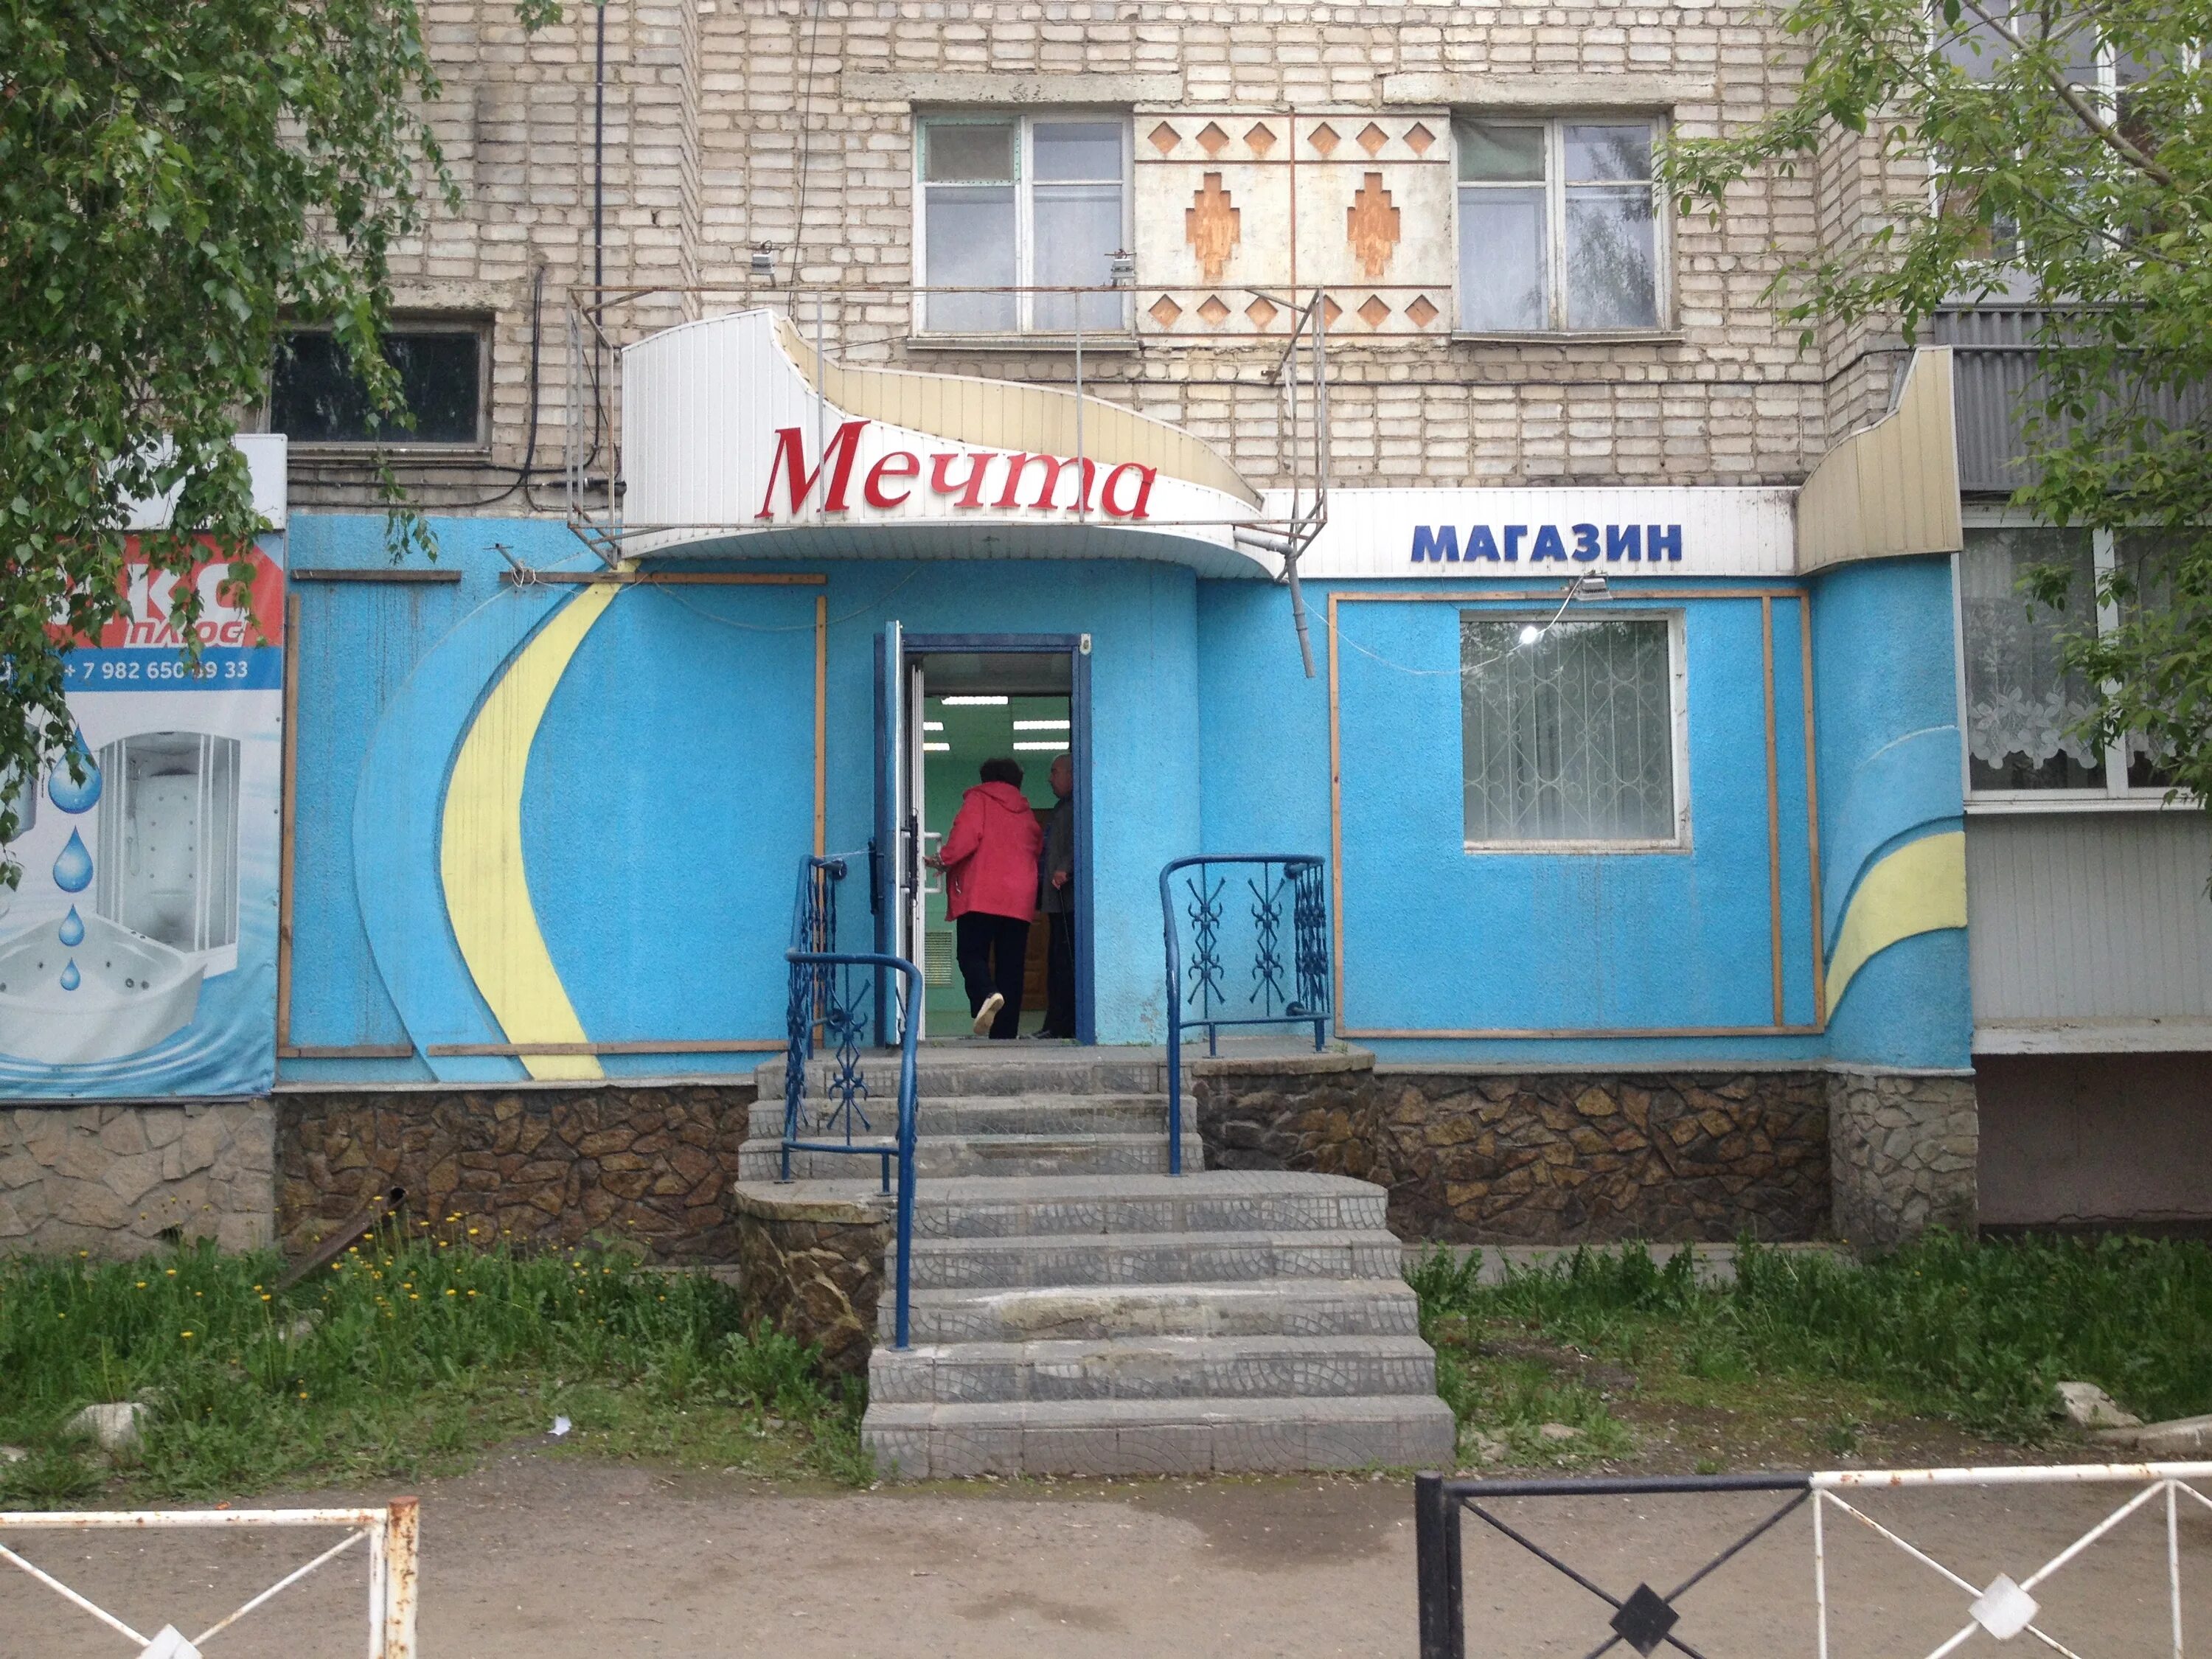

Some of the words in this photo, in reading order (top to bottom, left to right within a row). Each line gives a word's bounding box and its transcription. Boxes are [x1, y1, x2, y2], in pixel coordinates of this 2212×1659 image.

[754, 420, 1158, 519] Мечта
[1411, 523, 1683, 563] МАГАЗИН
[102, 661, 139, 678] 982
[147, 661, 184, 678] 650
[224, 661, 248, 678] 33
